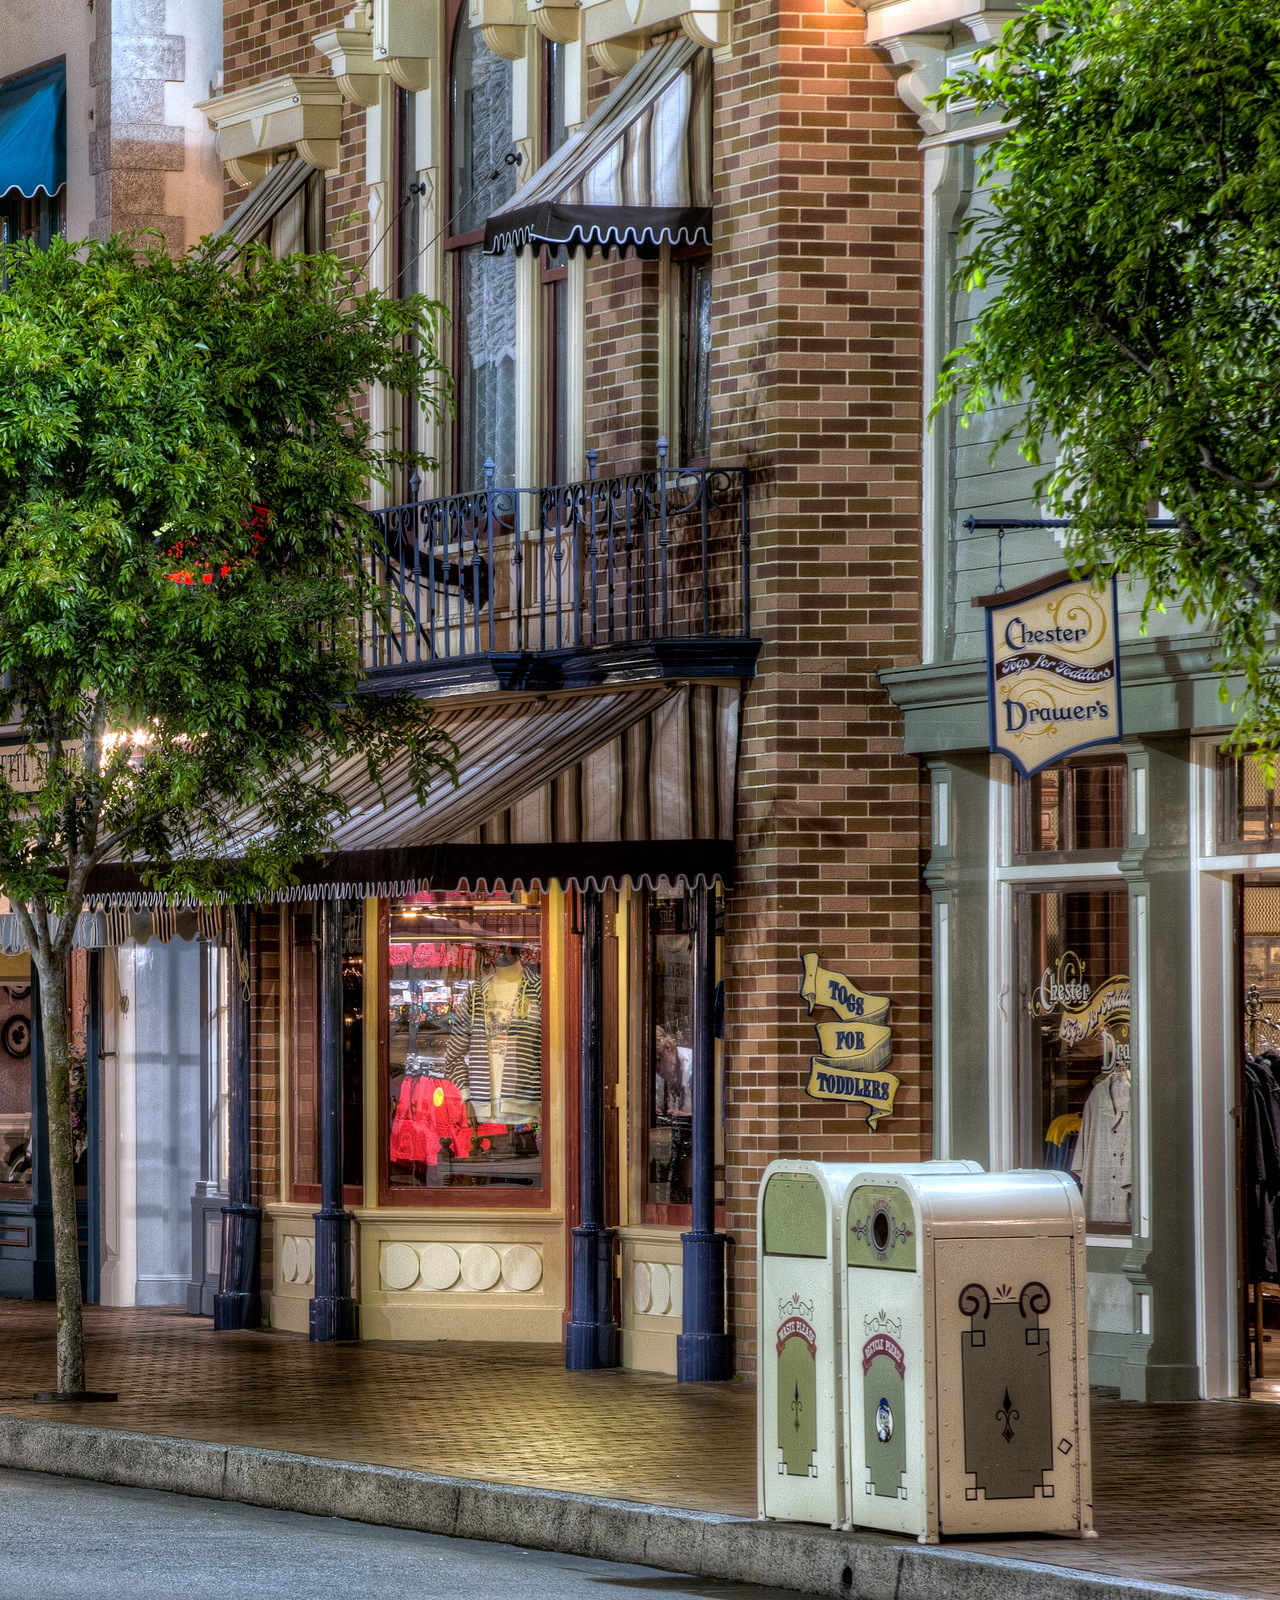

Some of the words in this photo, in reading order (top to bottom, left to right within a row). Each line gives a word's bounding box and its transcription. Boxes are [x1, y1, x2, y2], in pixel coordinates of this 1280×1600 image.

[1005, 617, 1087, 650] Chester
[1001, 656, 1030, 675] Togs
[1029, 654, 1056, 671] for
[1055, 660, 1111, 683] Toddlers
[1002, 698, 1109, 732] Drawer's
[828, 980, 865, 1016] TOGS
[1040, 967, 1091, 1013] Chester
[835, 1031, 866, 1050] FOR
[816, 1072, 890, 1101] TODDLERS
[778, 1321, 796, 1341] WASTE
[796, 1321, 815, 1344] PLEASE
[865, 1339, 884, 1359] RECYCLE
[885, 1339, 902, 1362] PLEASE
